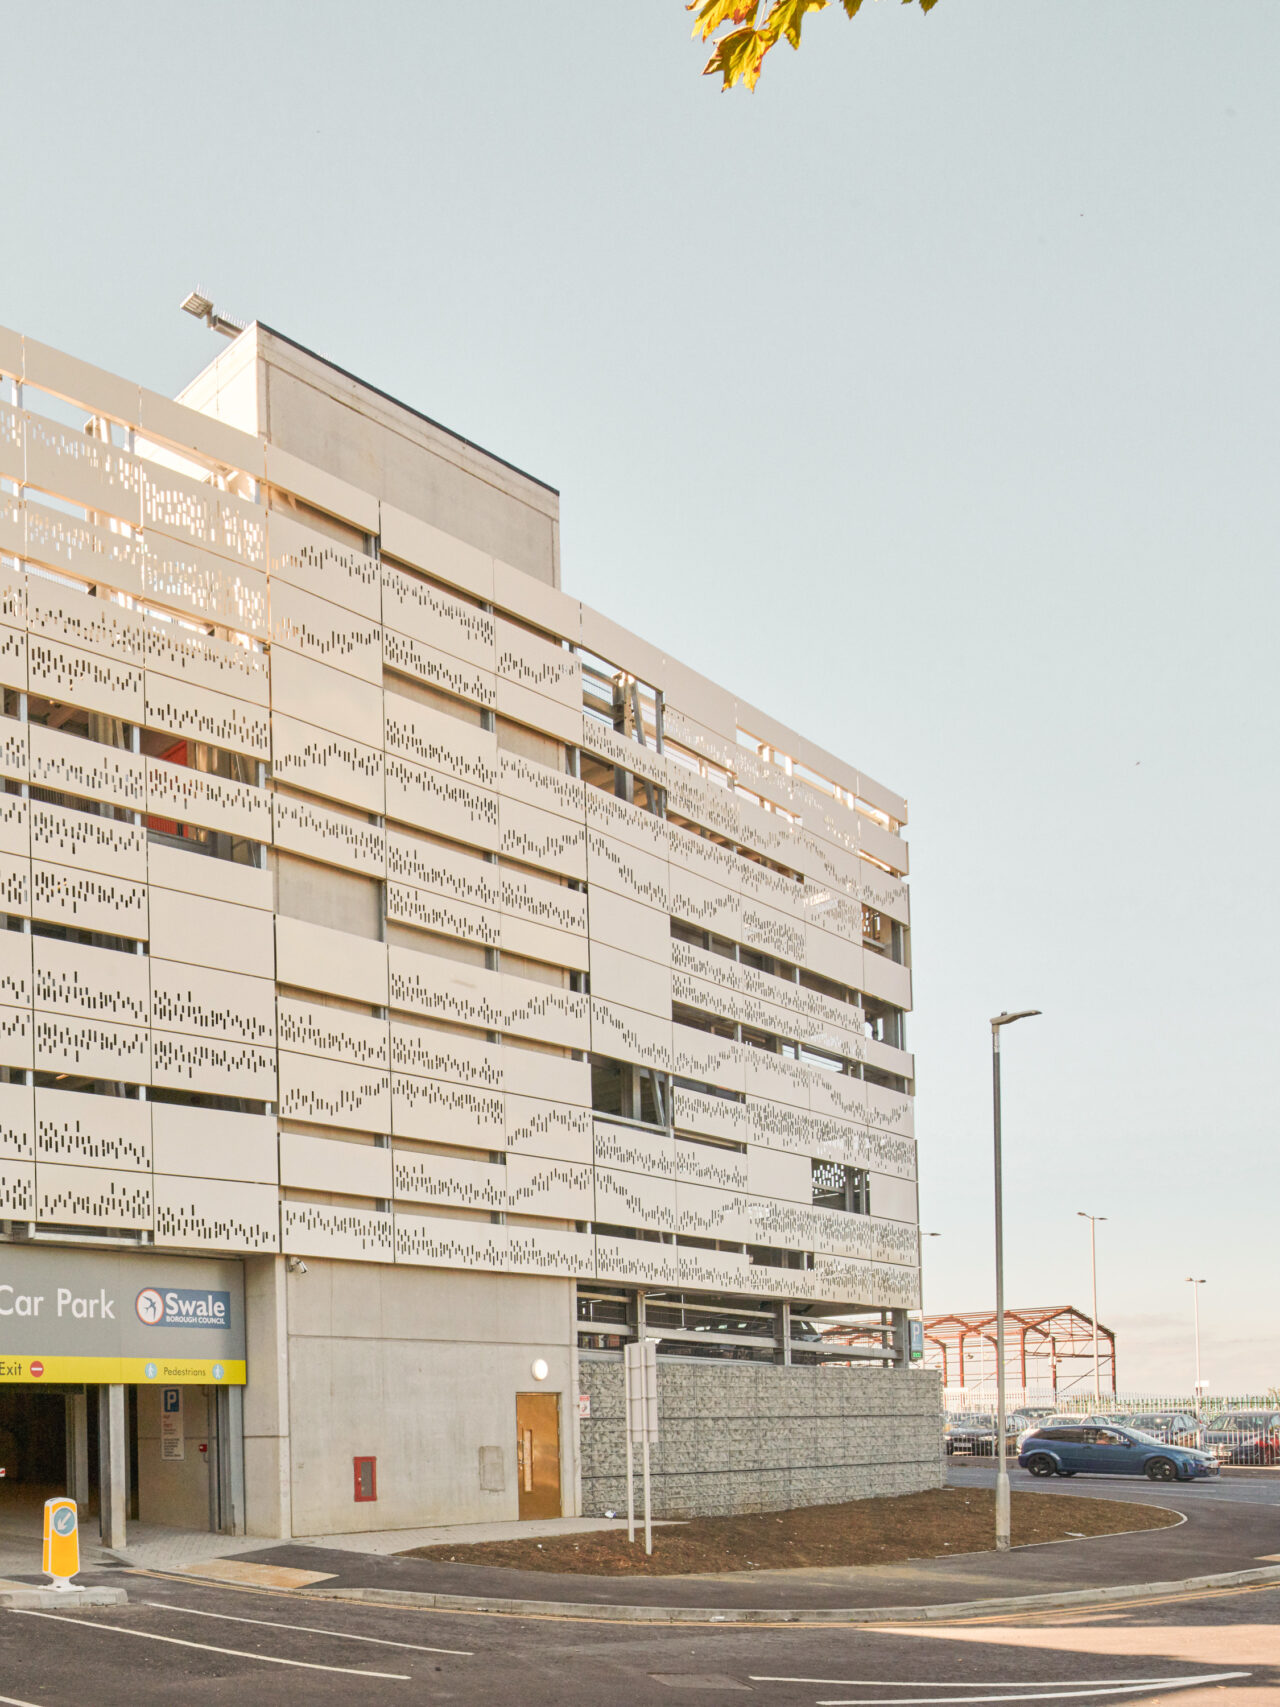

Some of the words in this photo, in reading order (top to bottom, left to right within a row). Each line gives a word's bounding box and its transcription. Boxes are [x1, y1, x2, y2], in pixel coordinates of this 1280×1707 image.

[57, 1287, 116, 1319] Park
[165, 1292, 226, 1317] Swale
[165, 1315, 198, 1324] BOROUGH
[198, 1316, 226, 1325] COUNCIL
[163, 1366, 207, 1377] Pedestrians
[166, 1391, 177, 1411] P
